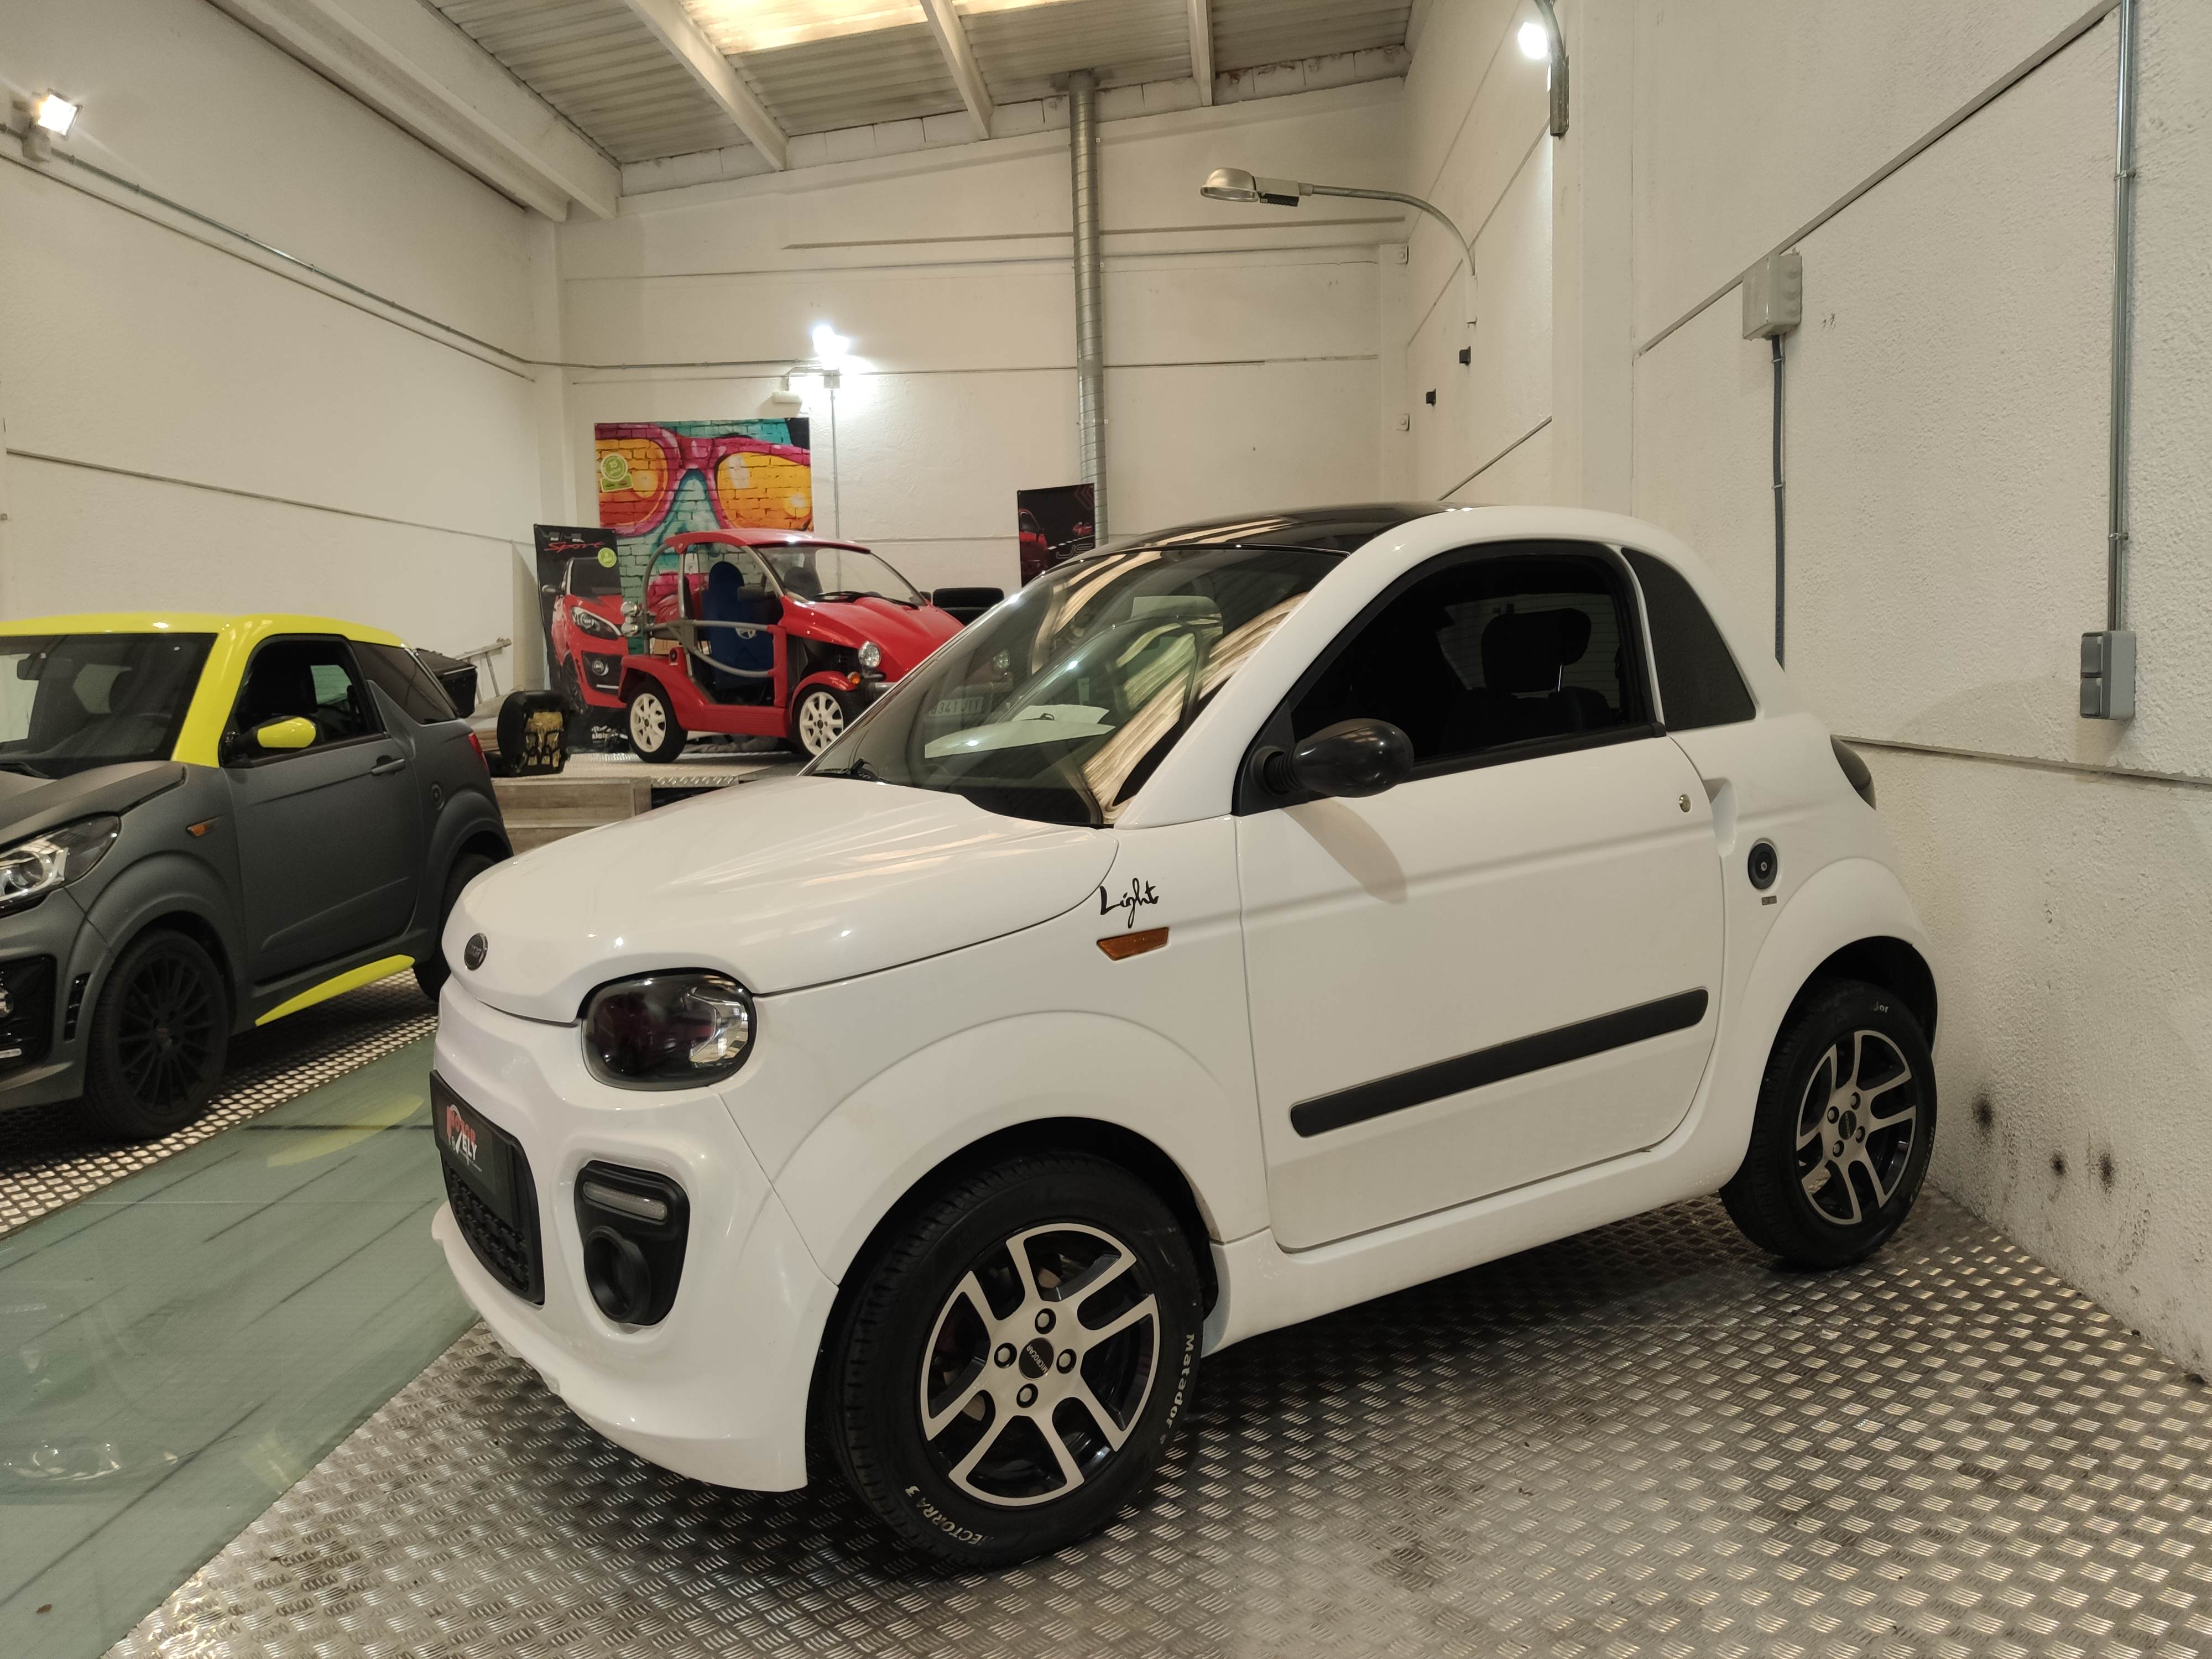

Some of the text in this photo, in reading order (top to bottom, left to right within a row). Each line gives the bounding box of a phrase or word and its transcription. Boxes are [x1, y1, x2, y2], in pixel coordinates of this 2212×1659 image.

[544, 541, 605, 553] Sport
[1099, 878, 1160, 929] Light
[1026, 1344, 1048, 1374] MICROCAR
[1165, 1333, 1195, 1429] Matador
